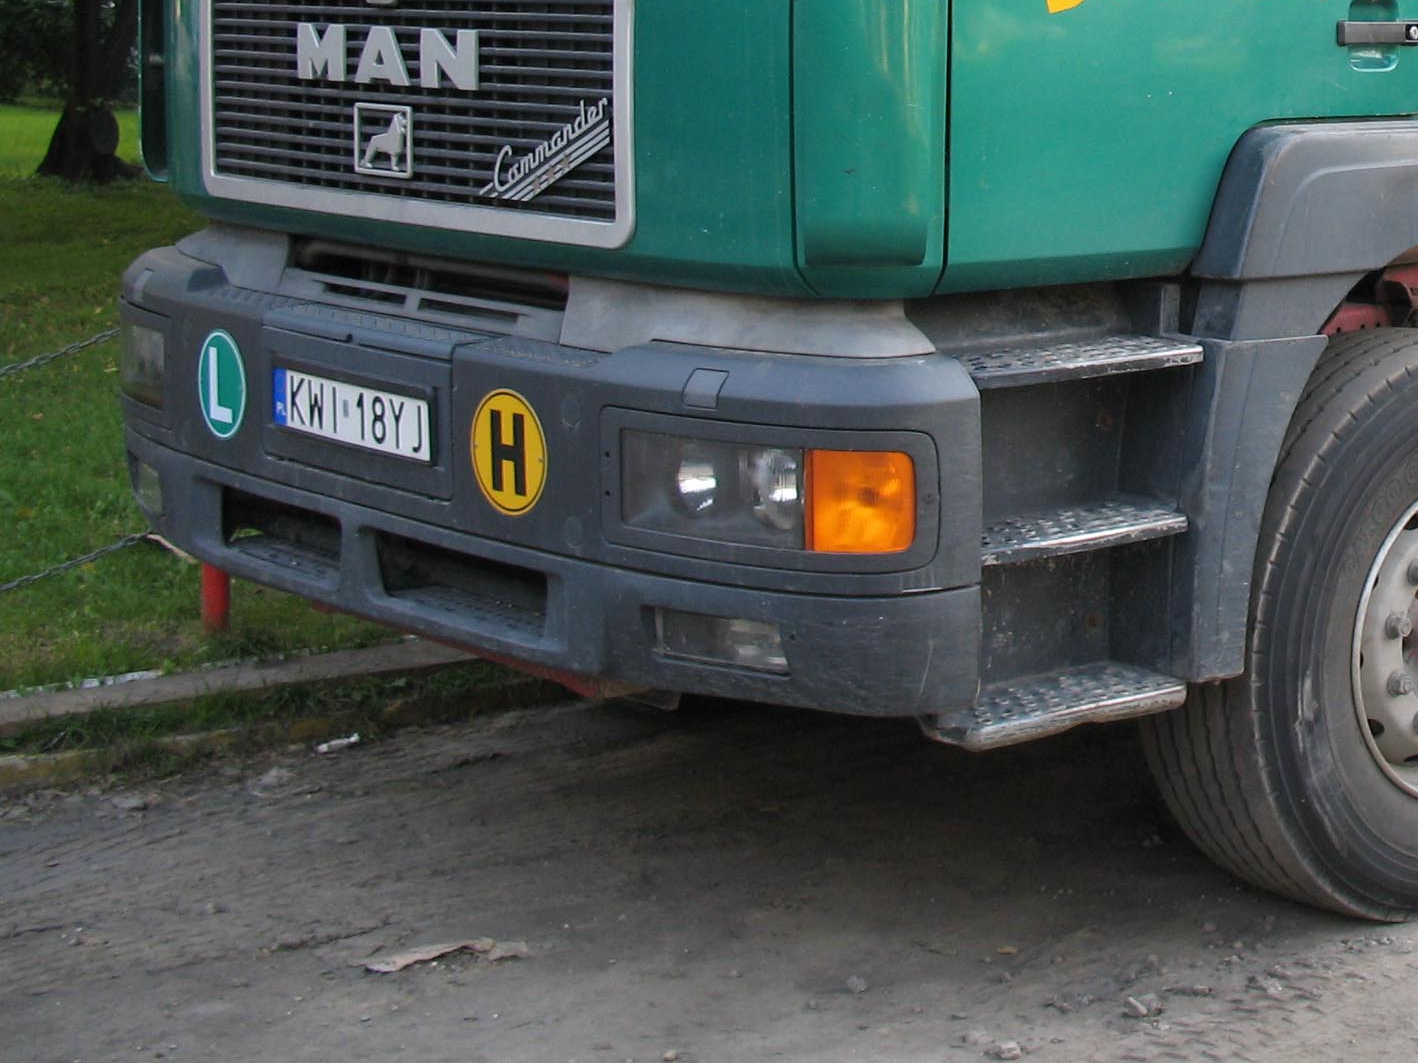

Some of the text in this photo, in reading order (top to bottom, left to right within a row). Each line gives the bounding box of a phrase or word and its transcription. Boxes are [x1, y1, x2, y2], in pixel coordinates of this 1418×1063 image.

[296, 22, 480, 92] MAN
[494, 97, 608, 193] Commander
[208, 346, 233, 424] L
[276, 402, 286, 416] PL
[290, 375, 423, 454] KWI 18YJ
[490, 408, 527, 497] H
